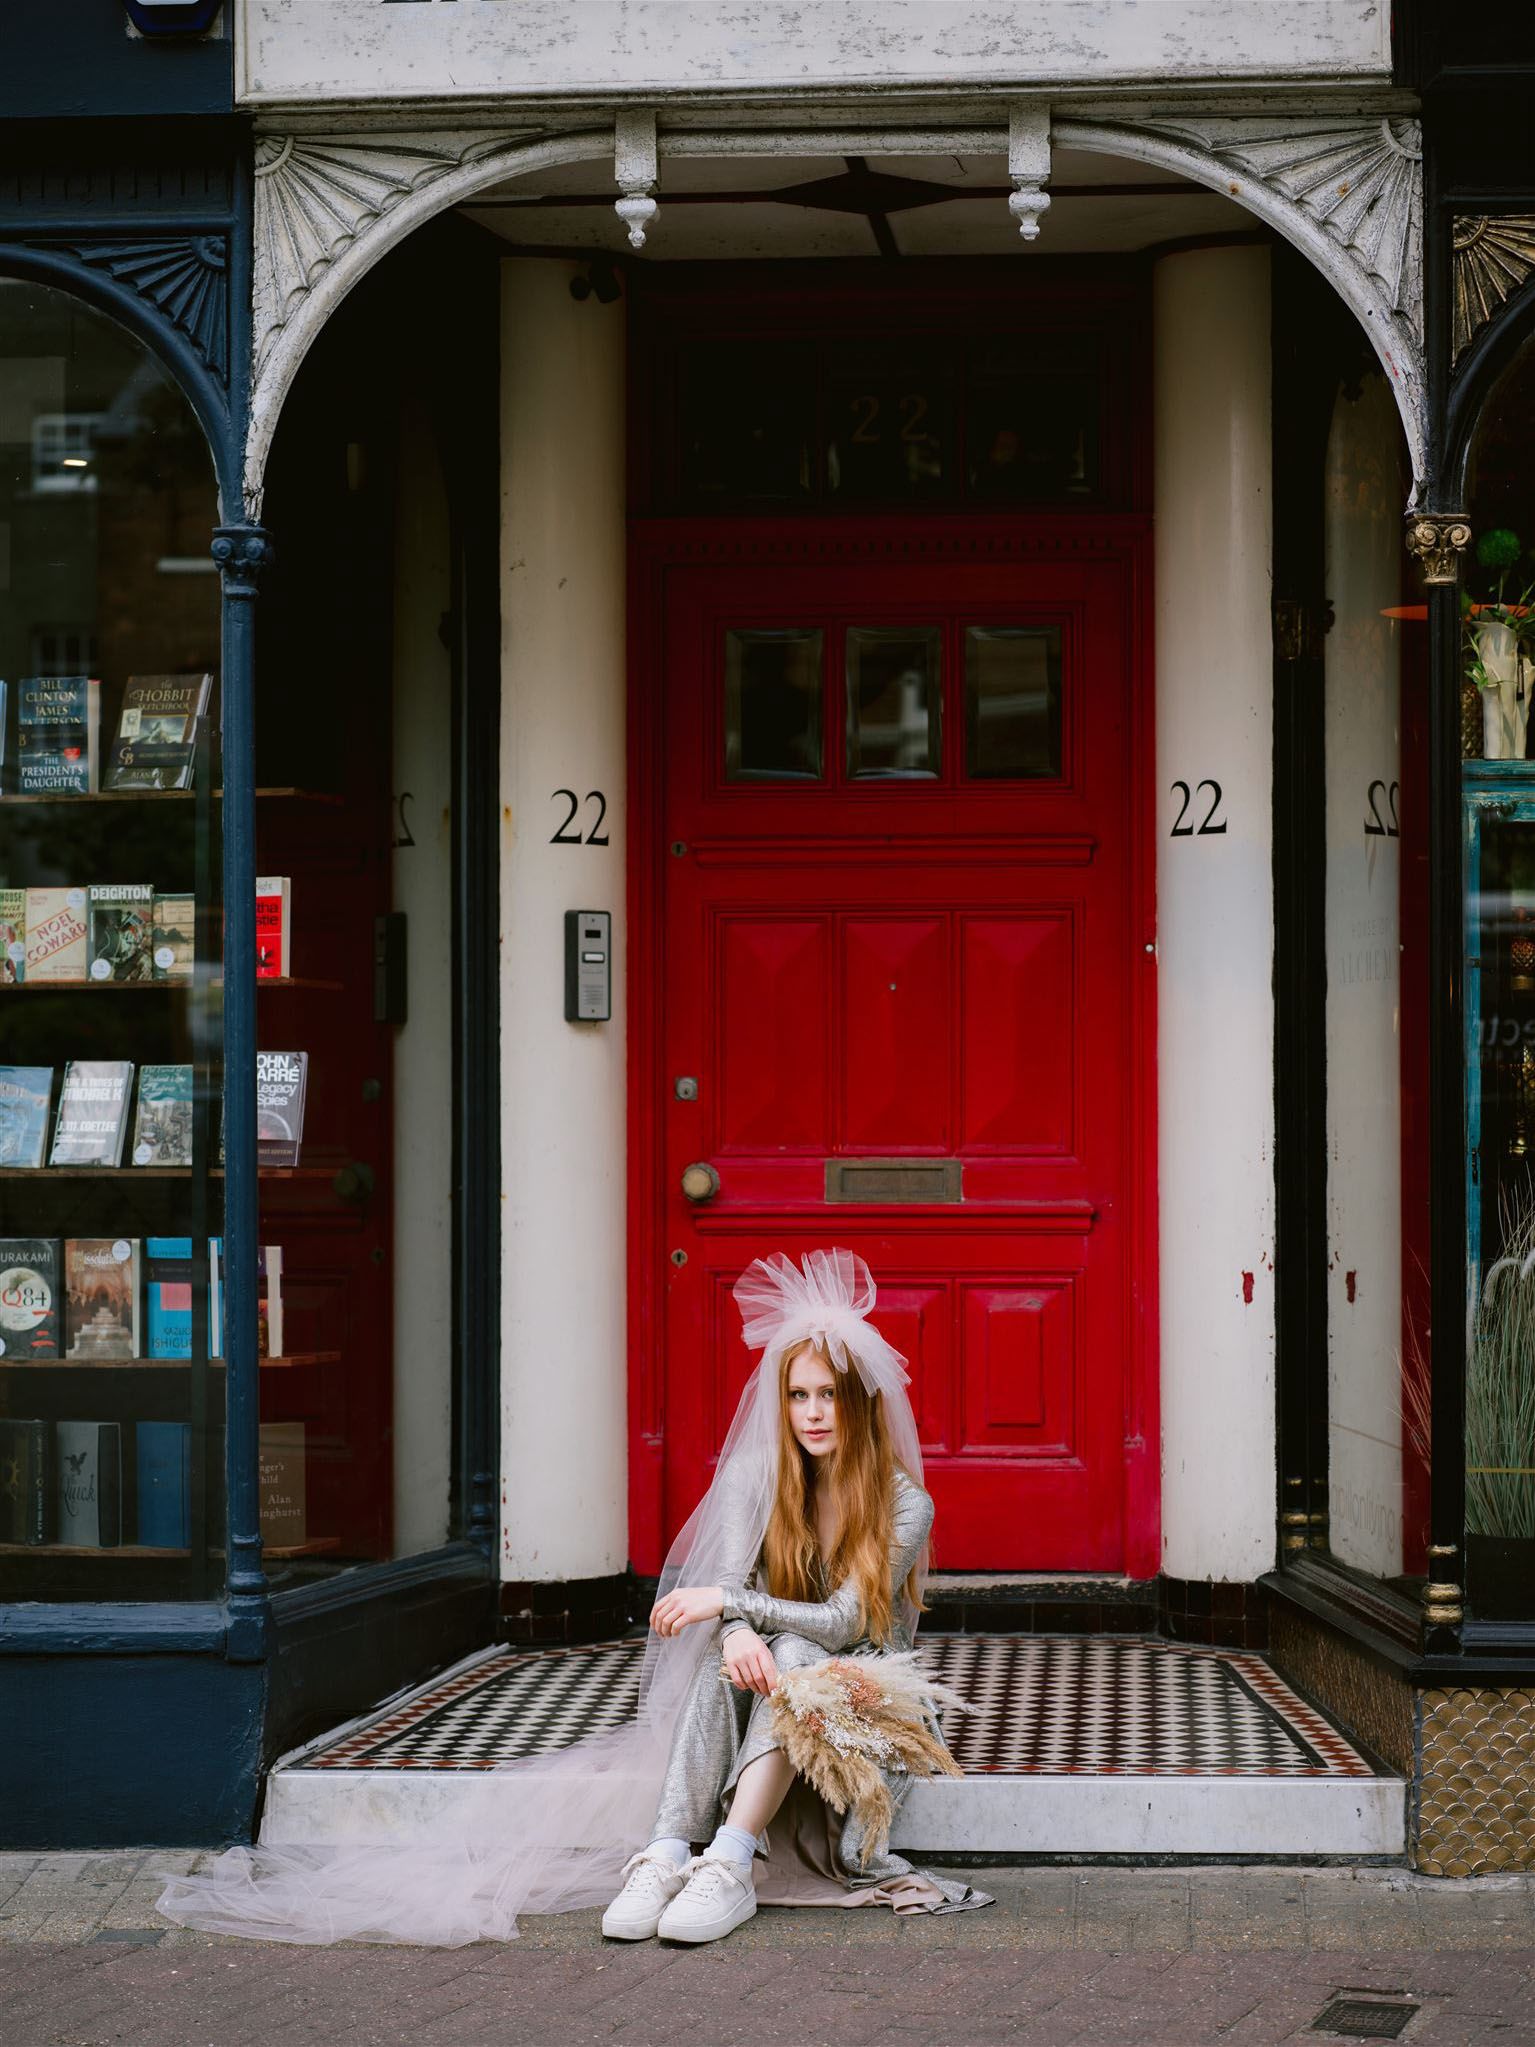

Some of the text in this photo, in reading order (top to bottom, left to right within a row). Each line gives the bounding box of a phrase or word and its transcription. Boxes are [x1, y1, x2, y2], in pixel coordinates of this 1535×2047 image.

[40, 680, 63, 690] BILL
[26, 691, 77, 702] CLINTON
[137, 689, 194, 702] HOBBIT
[36, 705, 70, 717] JAMES
[44, 757, 60, 765] THE
[21, 765, 84, 777] PRESIDENT'S
[24, 776, 82, 789] DAUGHTER
[1170, 779, 1229, 838] 22
[550, 788, 610, 847] 22
[91, 886, 151, 901] DEIGHTON
[37, 913, 76, 940] NOEL
[27, 922, 87, 962] COWARD
[257, 1054, 290, 1069] OHN
[257, 1065, 300, 1083] ARRÉ
[257, 1082, 298, 1097] Legacy
[257, 1094, 289, 1108] Spies
[0, 1252, 51, 1263] URAKAMI
[259, 1474, 279, 1485] hild
[268, 1494, 292, 1505] Alan
[259, 1507, 302, 1520] inghurst
